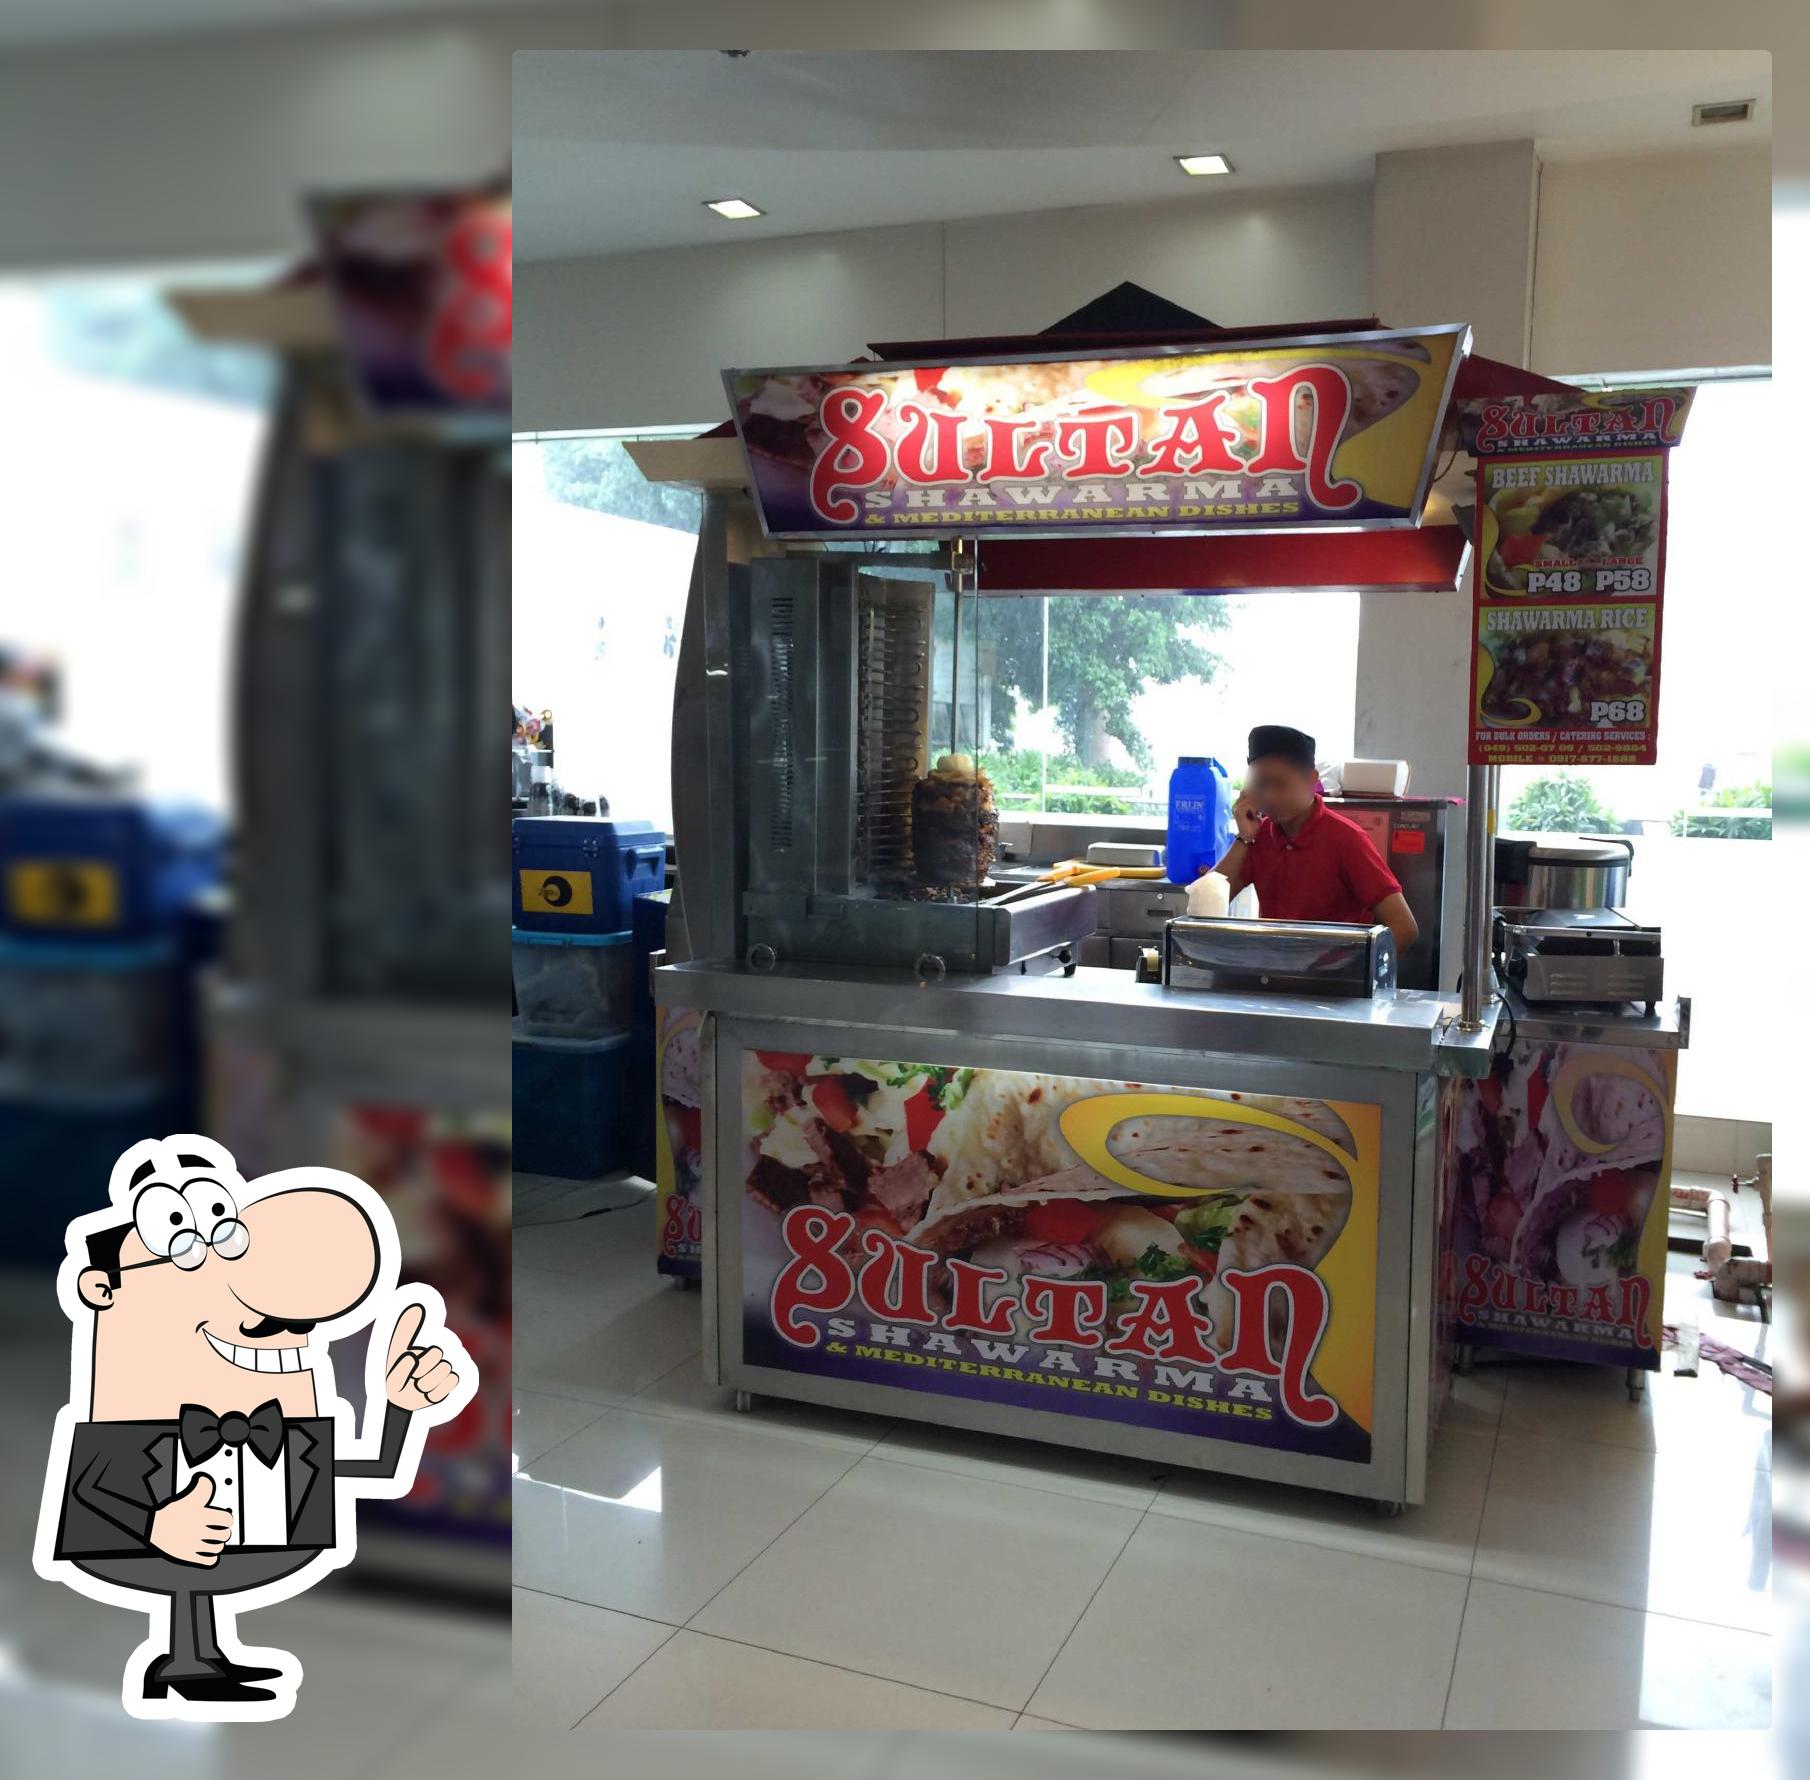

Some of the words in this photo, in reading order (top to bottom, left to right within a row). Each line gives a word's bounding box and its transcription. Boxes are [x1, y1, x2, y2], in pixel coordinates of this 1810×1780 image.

[1476, 397, 1680, 453] SULTAN
[809, 362, 1363, 526] SULTAN
[1497, 432, 1658, 448] SHAWARMA
[1492, 466, 1541, 489] BEEF
[1545, 461, 1654, 487] SHAWARMA
[865, 478, 1299, 509] SHAWARMA
[864, 513, 886, 525] &
[893, 505, 1169, 524] MEDITERRANEAN
[1178, 502, 1299, 518] DISHES
[1534, 558, 1577, 568] SMALL
[1602, 556, 1644, 566] LARGE
[1527, 569, 1582, 593] P48
[1595, 568, 1650, 592] P58
[1487, 608, 1597, 631] SHAWARMA
[1600, 606, 1649, 629] RICE
[1590, 701, 1645, 722] P68
[1476, 732, 1491, 741] FOR
[1494, 732, 1515, 741] BULK
[1518, 732, 1550, 741] ORDERS
[1560, 731, 1602, 741] CATERING
[1604, 731, 1645, 740] SERVICES
[1488, 755, 1533, 764] MOBILE
[771, 1205, 1339, 1426] SULTAN
[1458, 1253, 1655, 1350] SULTAN
[1477, 1310, 1633, 1341] SHAWARMA
[827, 1317, 1272, 1402] SHAWARMA
[826, 1342, 842, 1353] &
[855, 1344, 1138, 1399] MEDITERRANEAN
[1147, 1389, 1273, 1420] DISHES
